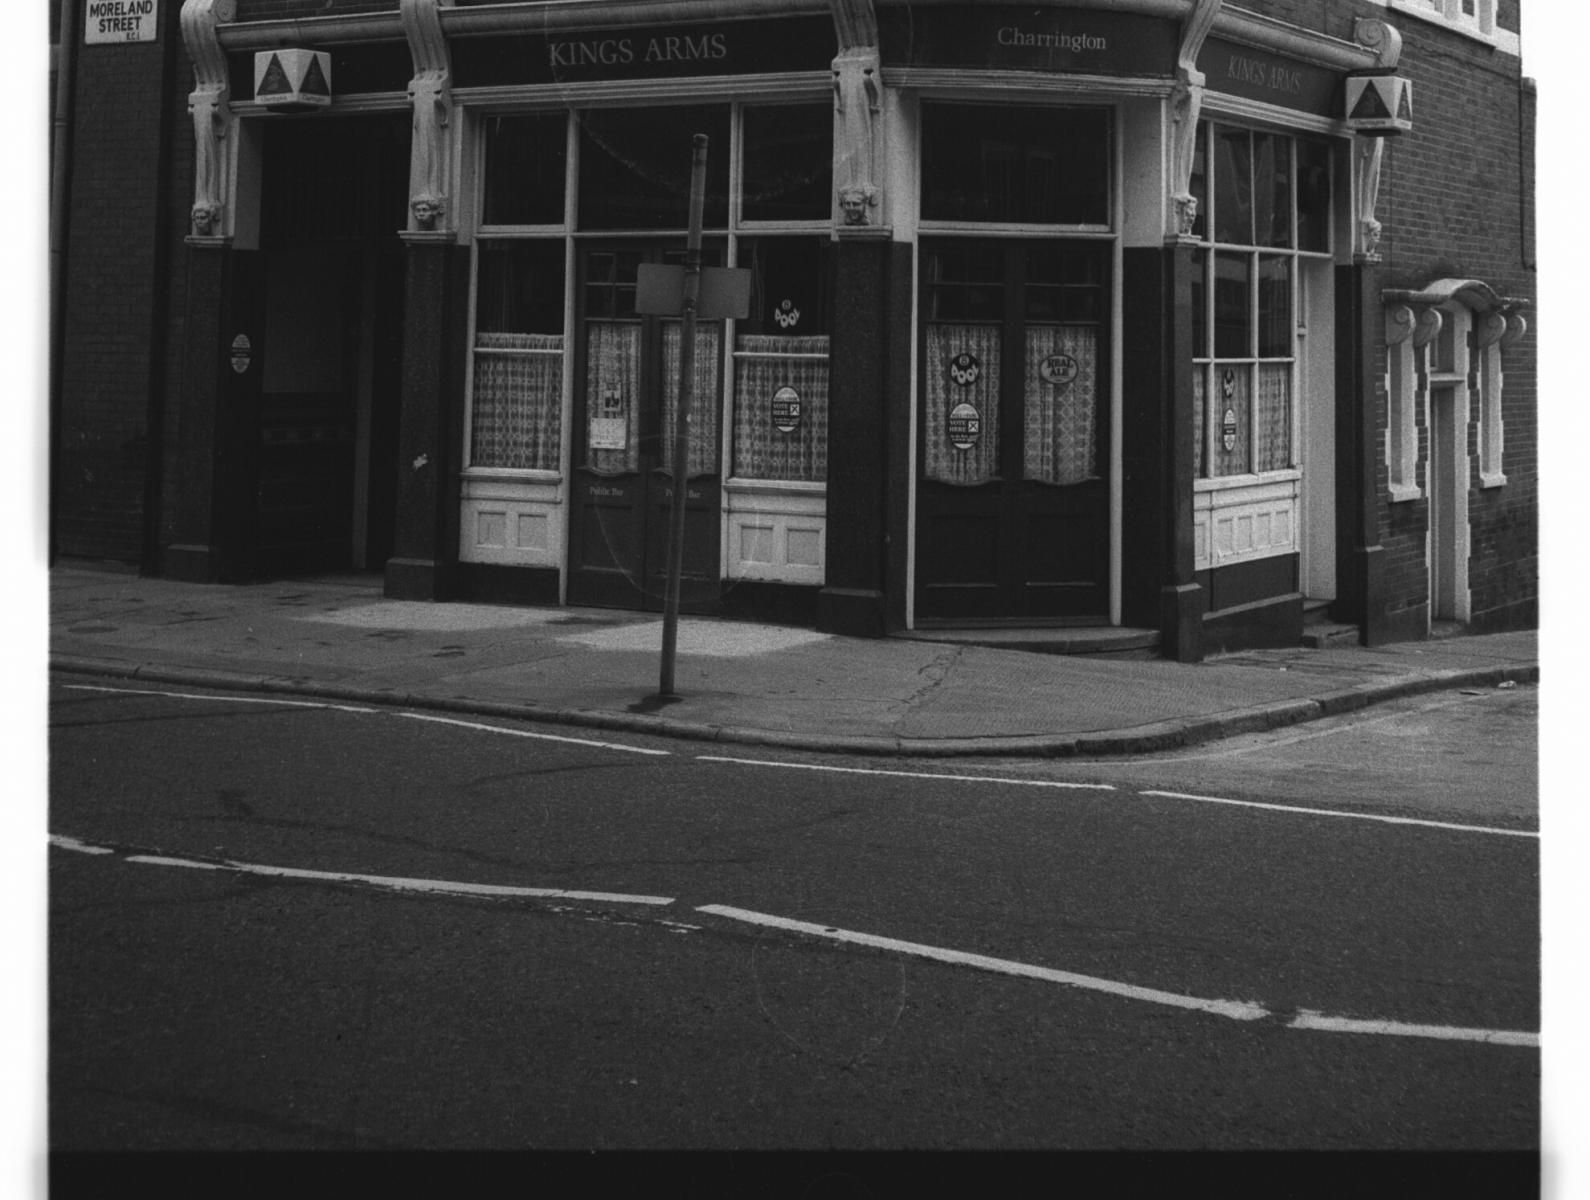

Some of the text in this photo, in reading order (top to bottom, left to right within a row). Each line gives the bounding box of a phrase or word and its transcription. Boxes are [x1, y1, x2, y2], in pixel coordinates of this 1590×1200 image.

[90, 0, 153, 18] MORELAND
[99, 16, 142, 33] STREET
[550, 33, 728, 67] KINGS ARMS
[998, 26, 1107, 53] Charrington
[1228, 55, 1302, 96] KINGS ARMS
[1047, 359, 1073, 368] REAL
